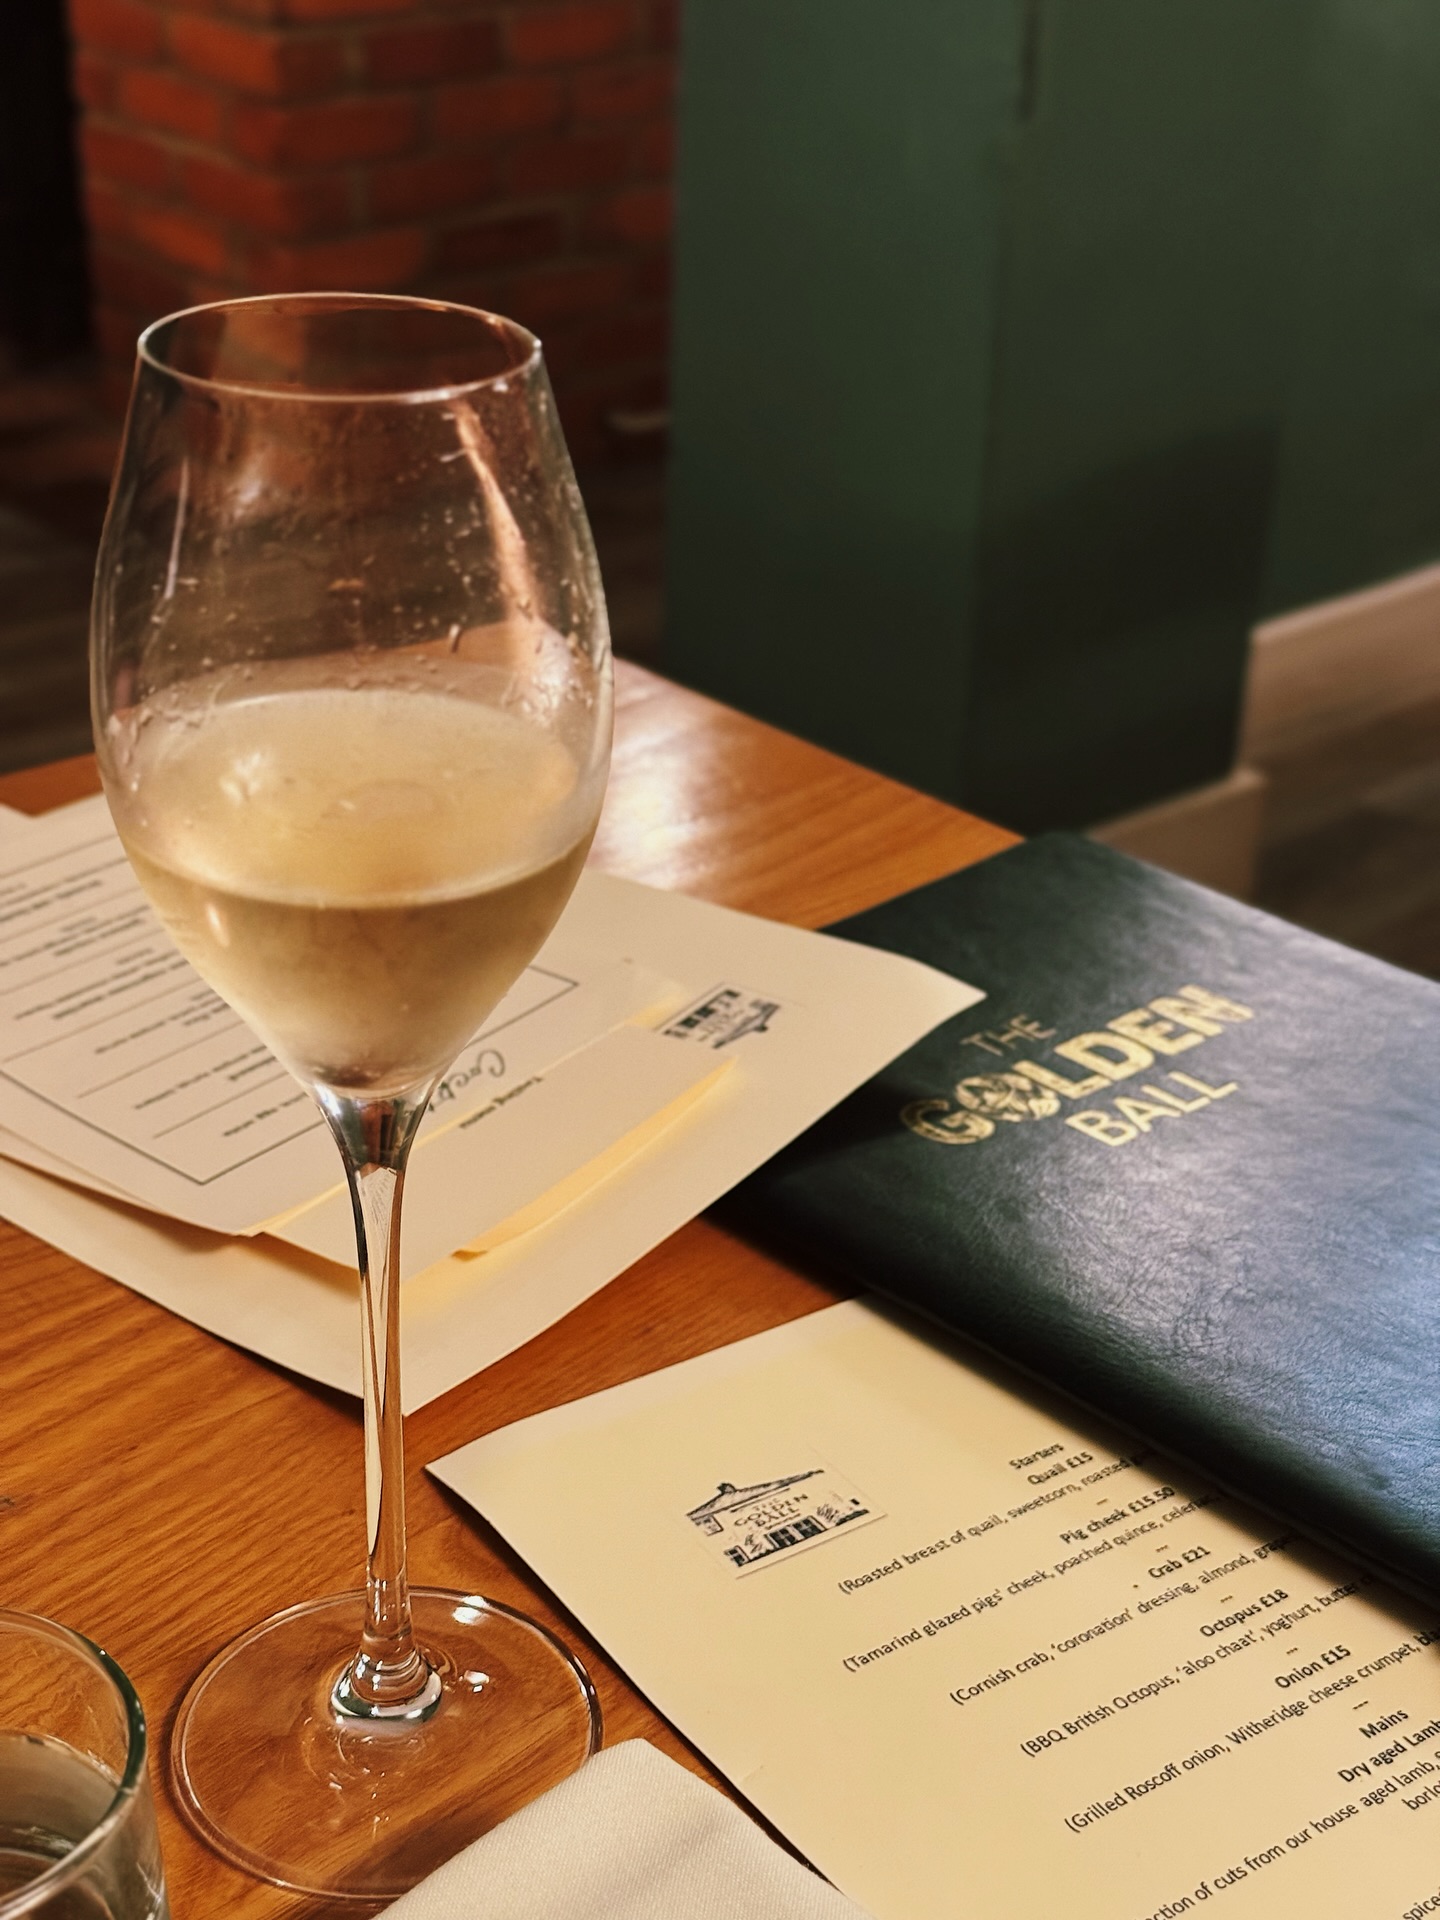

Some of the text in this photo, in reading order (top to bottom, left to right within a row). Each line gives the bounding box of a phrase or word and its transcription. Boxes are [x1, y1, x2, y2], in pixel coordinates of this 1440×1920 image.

[902, 984, 1253, 1144] GOLDEN
[959, 1013, 1057, 1056] THE
[1065, 1071, 1238, 1146] BALL
[1027, 1452, 1093, 1486] Quail £15
[838, 1559, 903, 1596] (Roasted
[902, 1538, 951, 1565] breast
[950, 1529, 967, 1546] of
[967, 1514, 1010, 1538] quail,
[1007, 1483, 1082, 1519] sweetcorn,
[1080, 1457, 1131, 1487] roasted
[1059, 1486, 1175, 1545] Pig cheek £15.50
[1148, 1545, 1212, 1579] Crab £21
[842, 1627, 923, 1674] (Tamarind
[922, 1604, 972, 1637] glazed
[1006, 1569, 1056, 1596] cheek,
[1054, 1538, 1114, 1576] poached
[1112, 1520, 1163, 1547] quince,
[1199, 1588, 1289, 1638] Octopus £18
[949, 1667, 1016, 1706] (Cornish
[1015, 1650, 1055, 1674] crab,
[1137, 1578, 1200, 1615] dressing,
[1198, 1552, 1257, 1586] almond,
[1020, 1728, 1068, 1758] (BBQ
[1062, 1704, 1116, 1736] British
[1112, 1673, 1181, 1710] Octopus,
[1262, 1602, 1322, 1638] yoghurt,
[1274, 1643, 1352, 1690] Onion £15
[1064, 1792, 1129, 1834] (Grilled
[1123, 1762, 1183, 1800] Roscoff
[1181, 1742, 1232, 1771] onion,
[1224, 1699, 1310, 1746] Witheridge
[1307, 1673, 1360, 1705] cheese
[1356, 1642, 1423, 1679] crumpet,
[1337, 1719, 1440, 1784] Dry aged Lamb
[1358, 1709, 1410, 1740] Mains
[1401, 1780, 1440, 1811] borlo
[1143, 1761, 1440, 1920] ction of cuts from our house aged lamb,
[1402, 1886, 1440, 1920] spice
